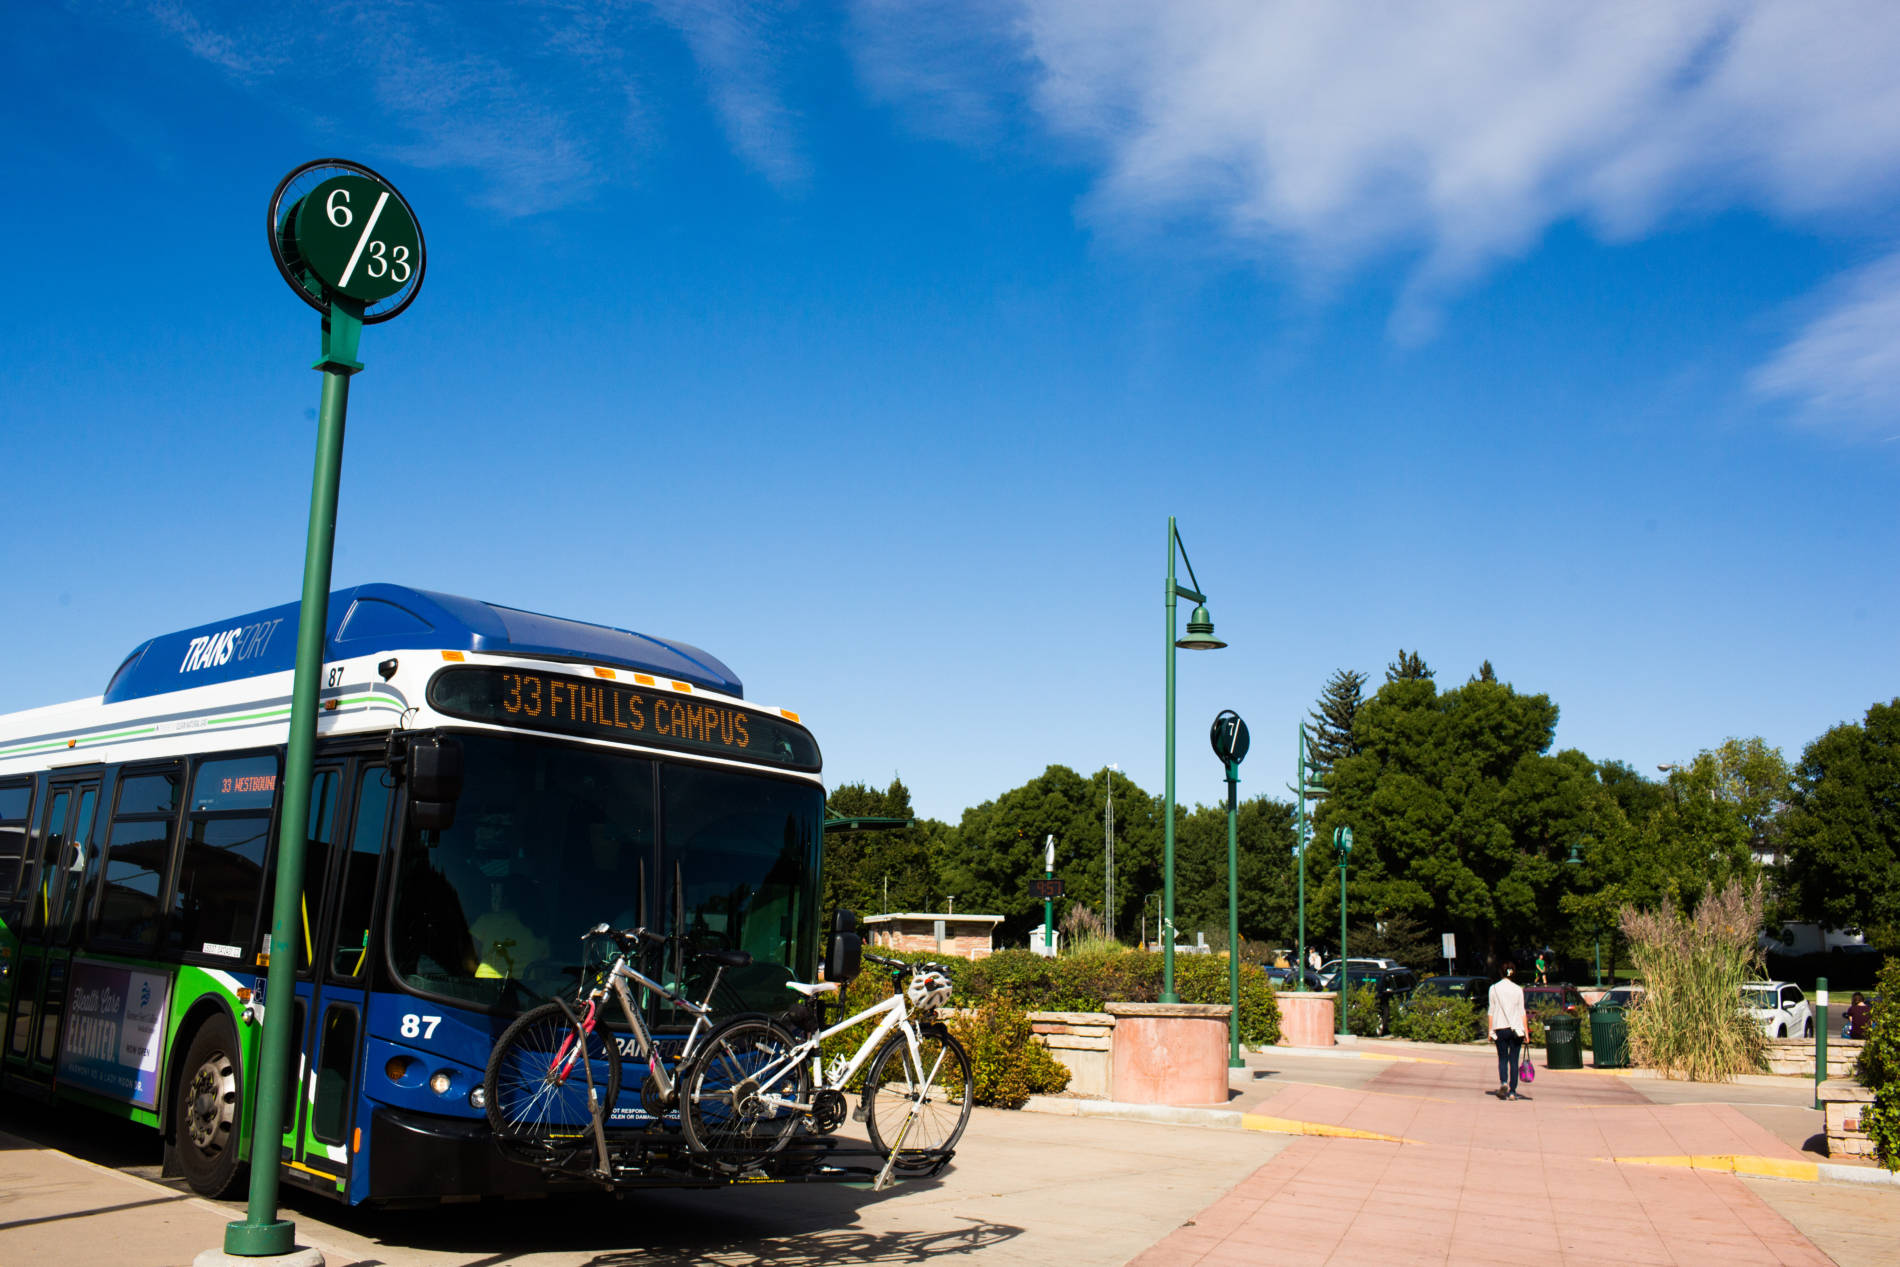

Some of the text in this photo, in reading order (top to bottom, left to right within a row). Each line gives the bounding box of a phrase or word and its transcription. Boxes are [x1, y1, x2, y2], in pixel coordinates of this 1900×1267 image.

[179, 618, 284, 674] TRANSFORT
[328, 666, 345, 688] 87
[503, 674, 750, 748] 33 FTHLLS CAMPUS
[221, 777, 232, 793] 33
[400, 1013, 442, 1039] 87
